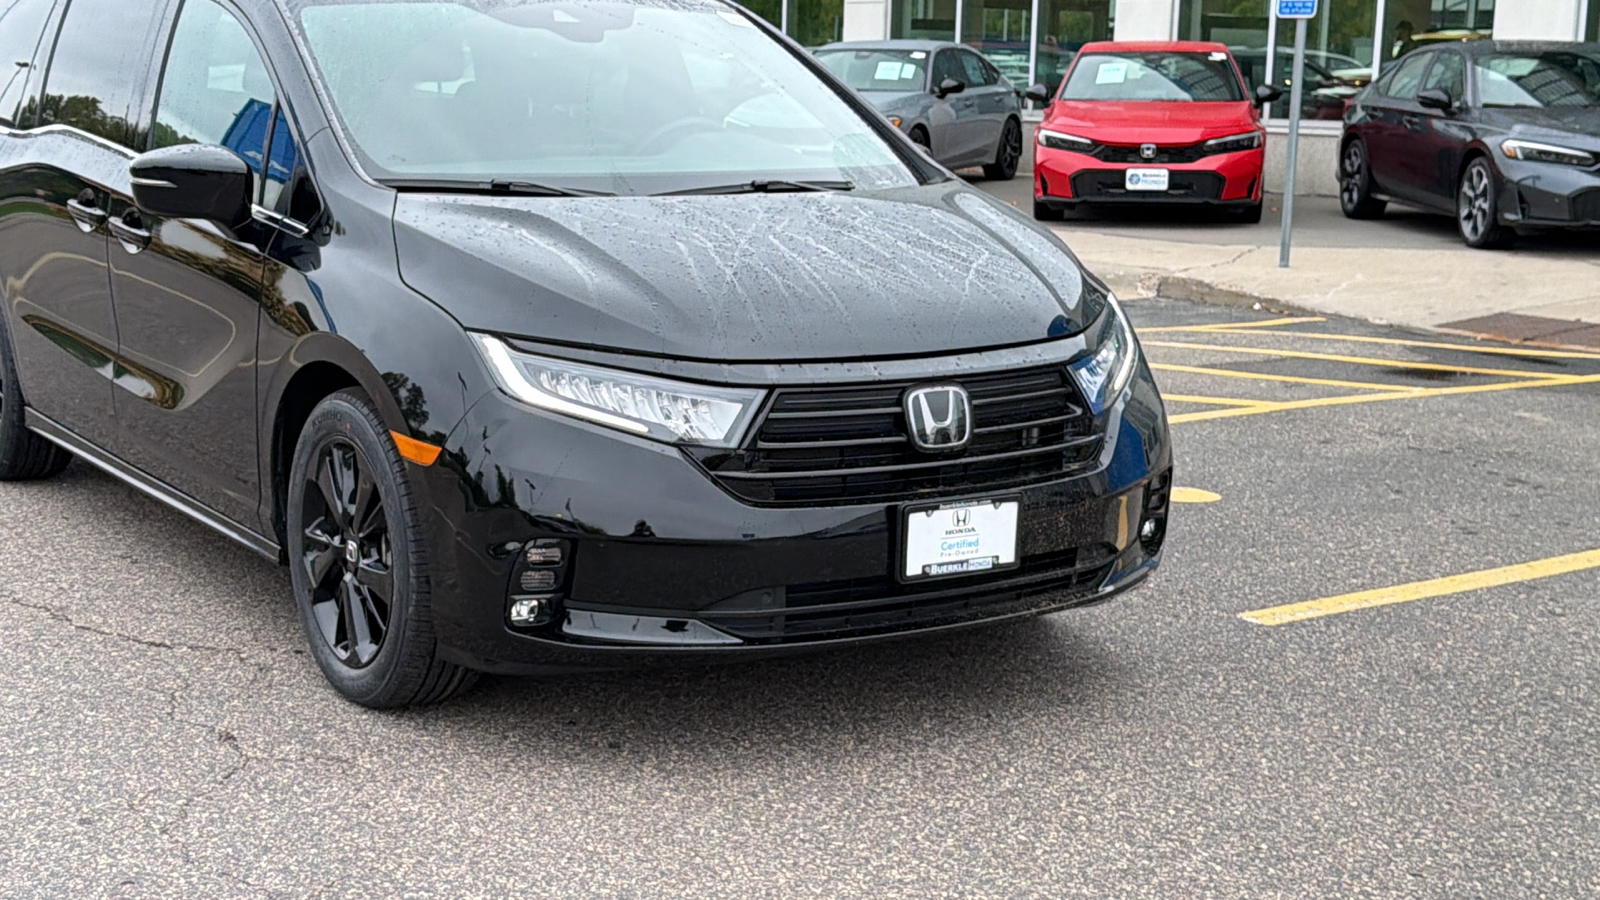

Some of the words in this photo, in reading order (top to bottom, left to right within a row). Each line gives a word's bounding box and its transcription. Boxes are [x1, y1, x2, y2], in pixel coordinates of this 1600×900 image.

[945, 526, 977, 536] HONDA
[941, 537, 980, 552] Certified
[940, 548, 980, 558] Pre-Owned
[969, 558, 992, 570] HONDA
